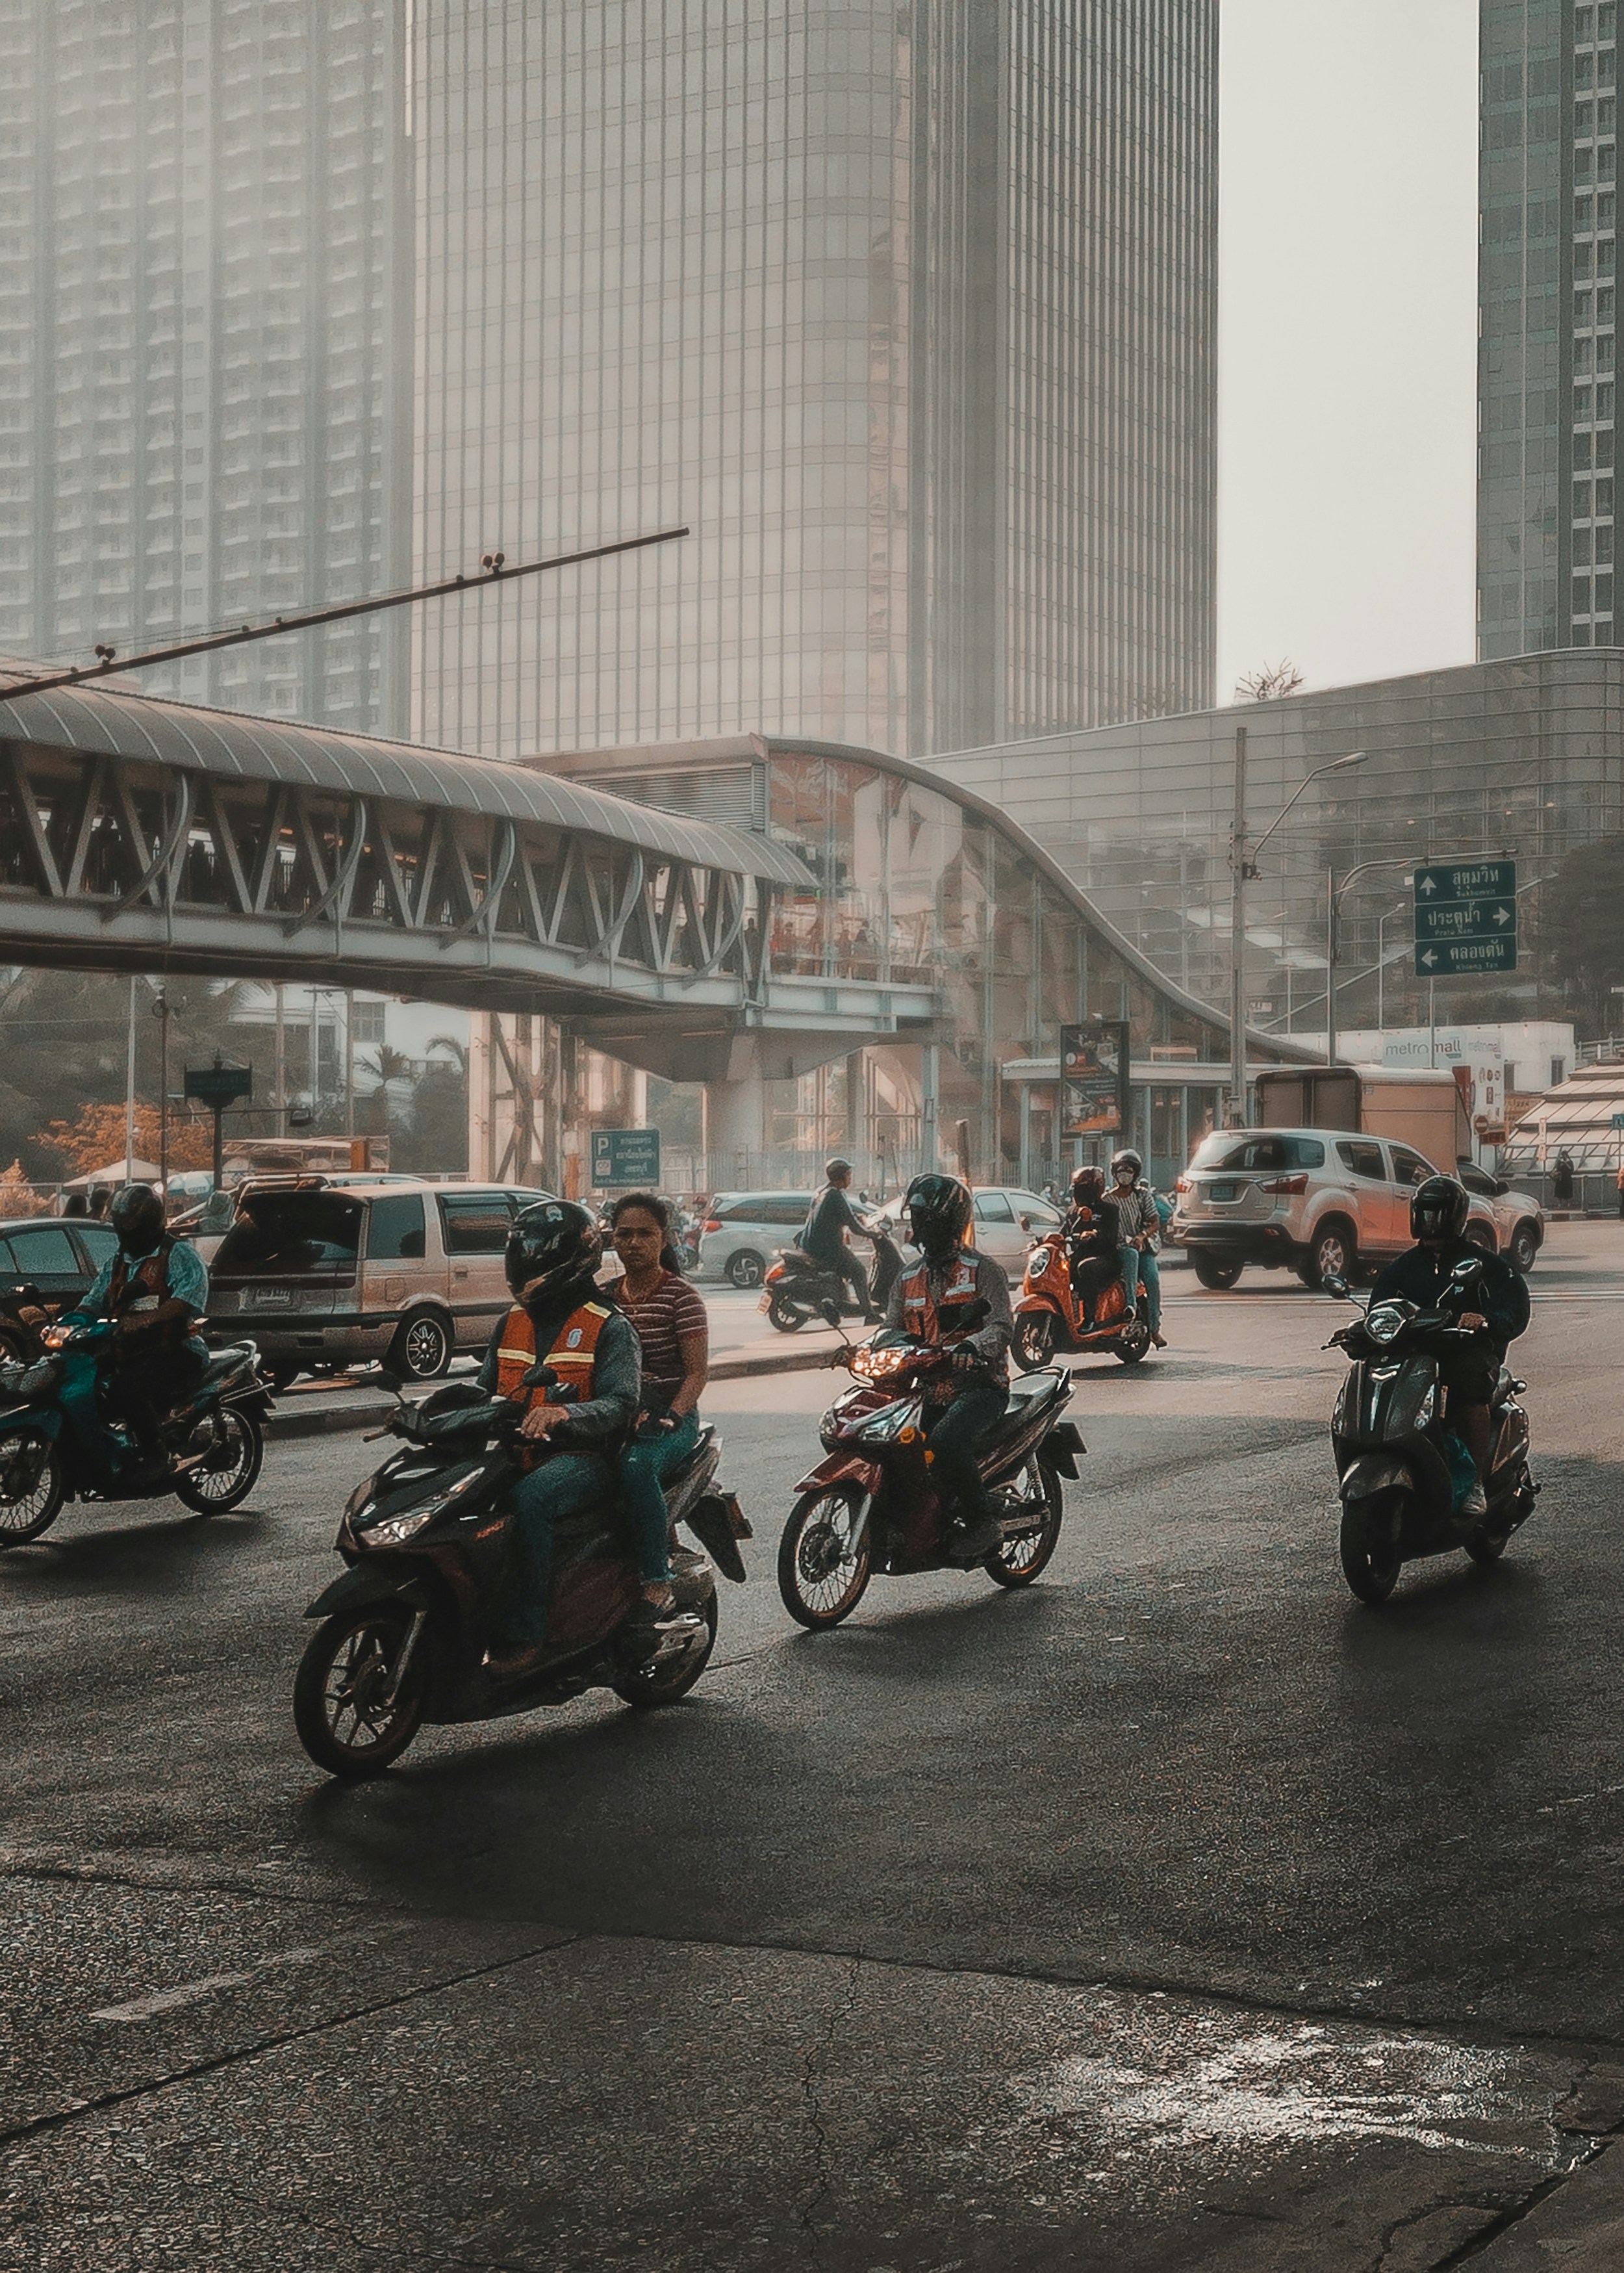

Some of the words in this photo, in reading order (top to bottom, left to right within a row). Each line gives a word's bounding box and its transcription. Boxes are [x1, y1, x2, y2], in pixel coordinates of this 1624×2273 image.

[1453, 865, 1499, 890] สุขุมวิท
[1428, 901, 1480, 932] ประตูน้ำ
[1450, 939, 1504, 960] คลองตัน
[598, 1137, 609, 1155] P
